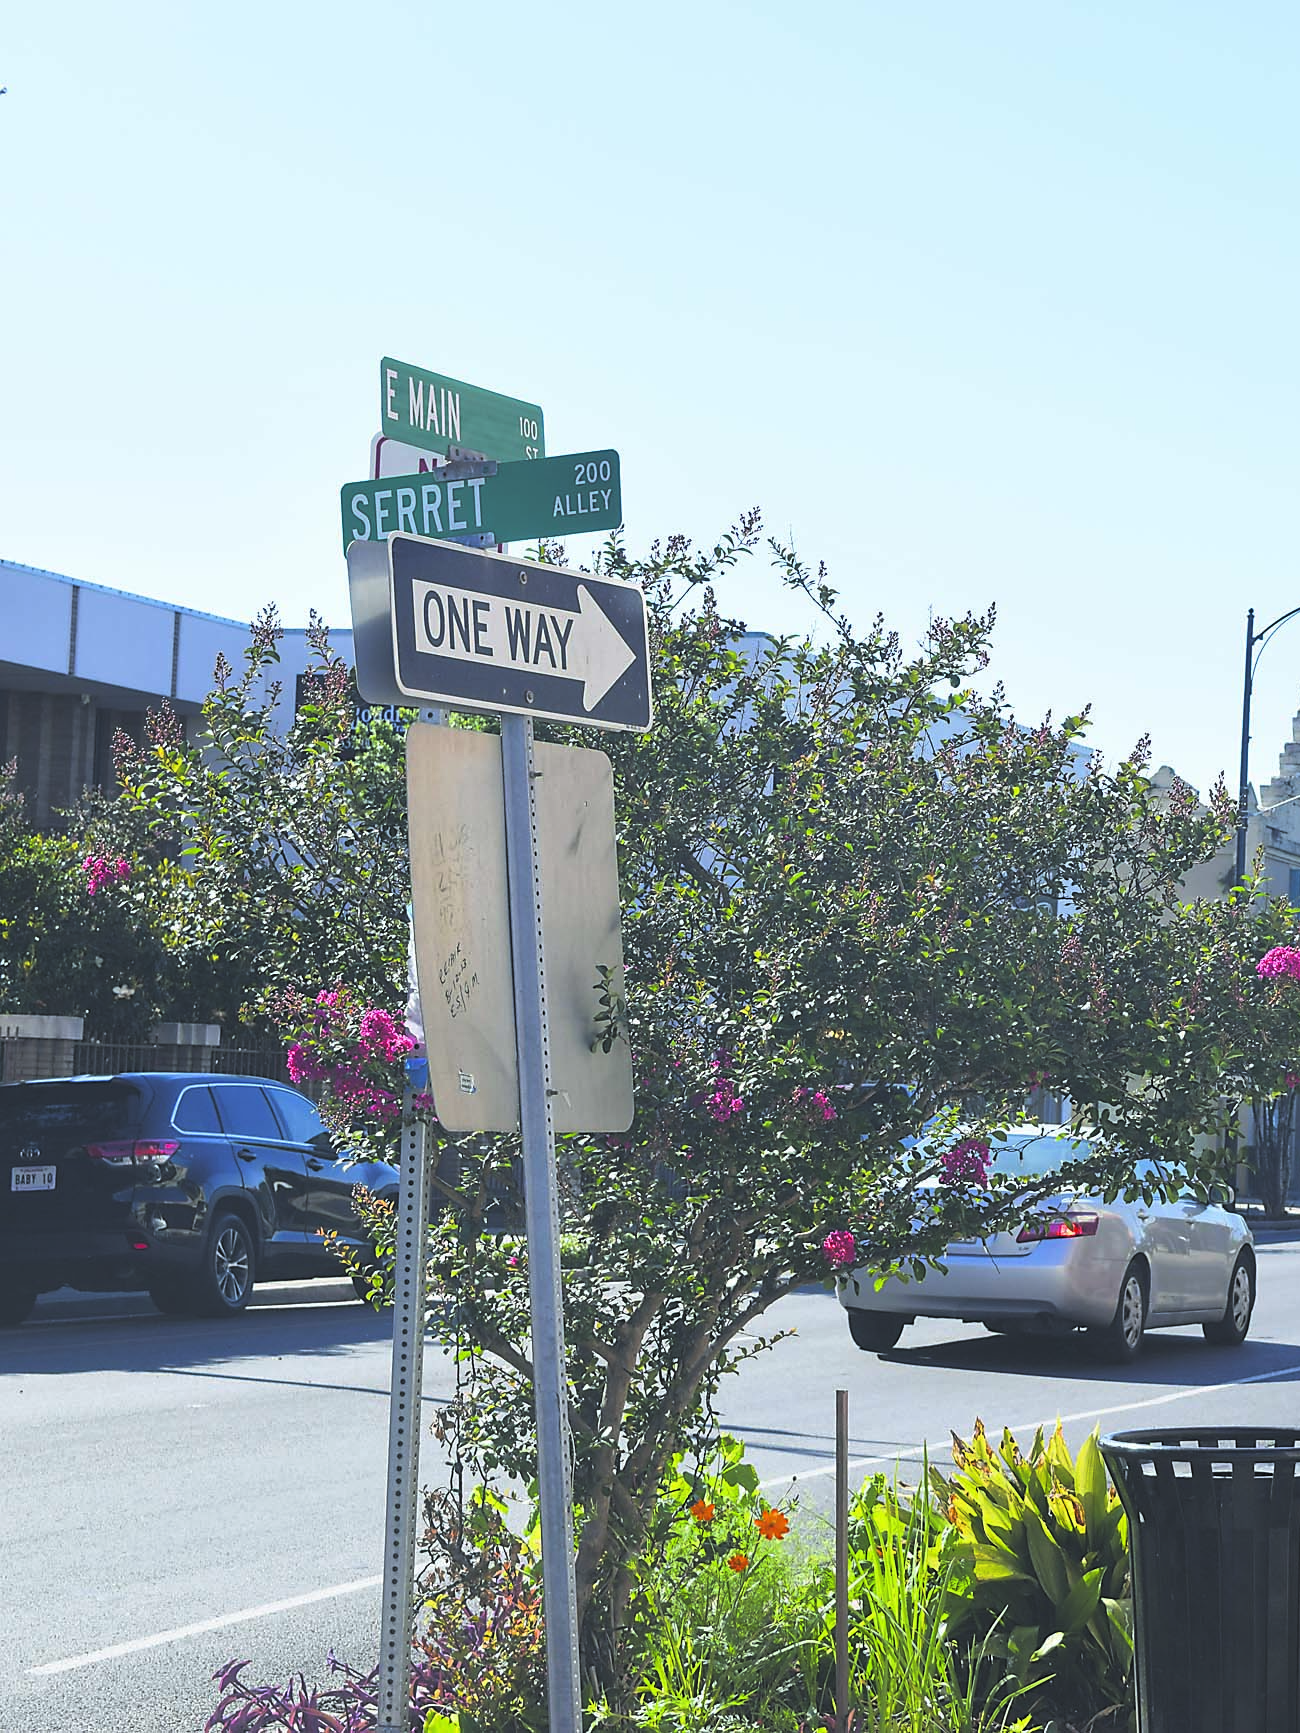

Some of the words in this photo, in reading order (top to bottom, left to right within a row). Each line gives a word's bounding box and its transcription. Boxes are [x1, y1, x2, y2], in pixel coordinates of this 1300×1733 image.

[386, 368, 399, 421] E
[408, 376, 462, 442] MAIN
[519, 416, 538, 440] 100
[525, 445, 539, 460] ST
[574, 460, 611, 485] 200
[351, 478, 486, 541] SERRET
[553, 489, 612, 517] ALLEY
[423, 590, 494, 656] ONE
[505, 606, 574, 670] WAY
[15, 1174, 36, 1185] BABY
